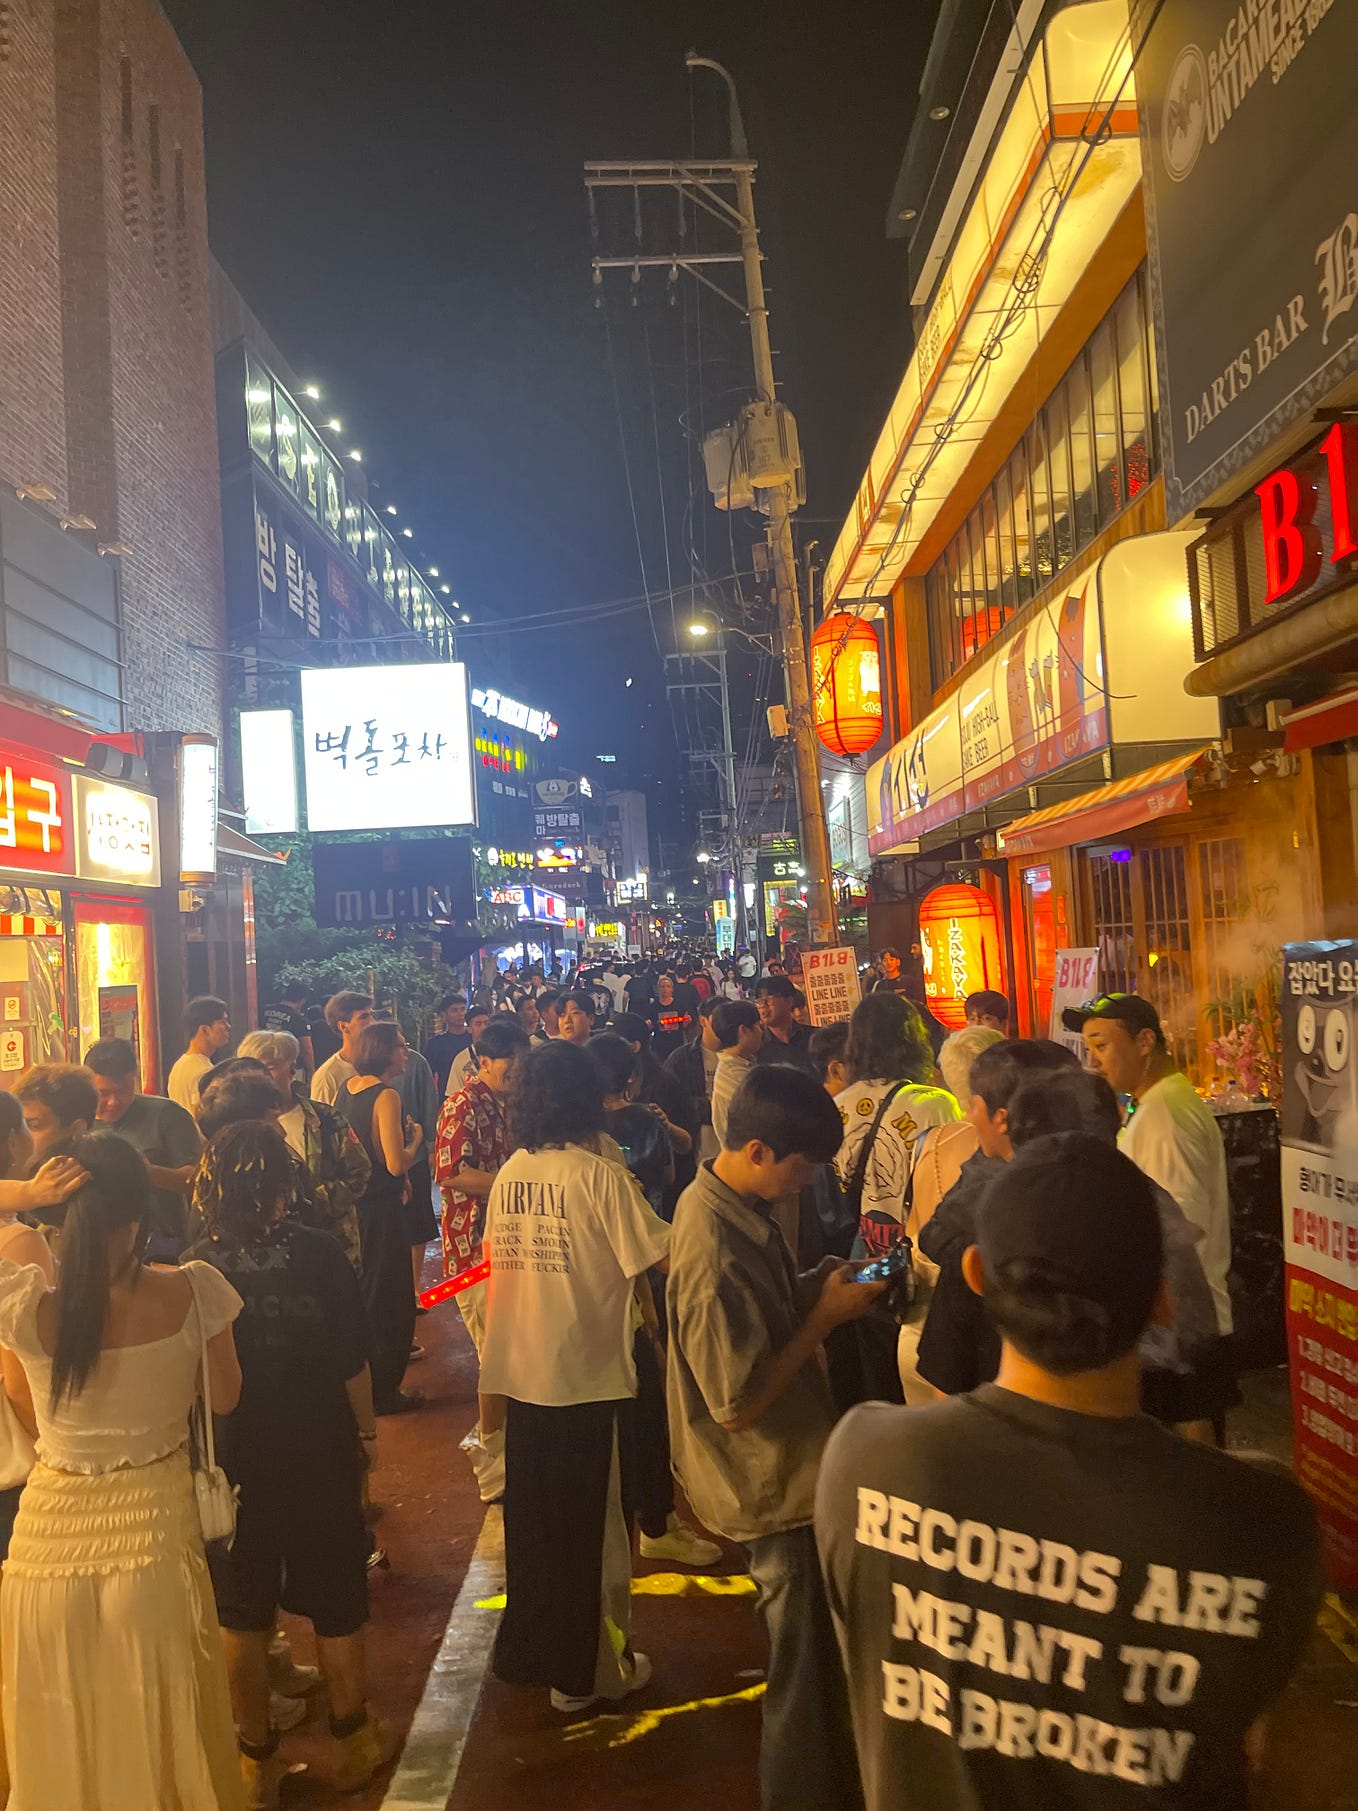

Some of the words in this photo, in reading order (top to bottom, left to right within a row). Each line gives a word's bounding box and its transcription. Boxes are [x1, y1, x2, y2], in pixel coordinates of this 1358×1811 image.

[1207, 0, 1268, 86] BACAR
[1271, 17, 1304, 85] SINCE
[1185, 347, 1252, 444] DARTS
[1254, 294, 1309, 375] BAR
[316, 718, 448, 776] 벽돌포차
[494, 891, 522, 904] ABC
[811, 988, 829, 1000] LINE
[829, 986, 848, 999] LINE
[949, 918, 967, 998] IZAKAYA
[1288, 960, 1336, 996] 잡았다
[1337, 959, 1358, 996] 요
[854, 1486, 1122, 1615] RECORDS
[1132, 1562, 1268, 1639] ARE
[890, 1582, 1104, 1692] MEANT
[1118, 1644, 1201, 1707] TO
[881, 1659, 953, 1738] BE
[958, 1687, 1196, 1788] BROKEN
